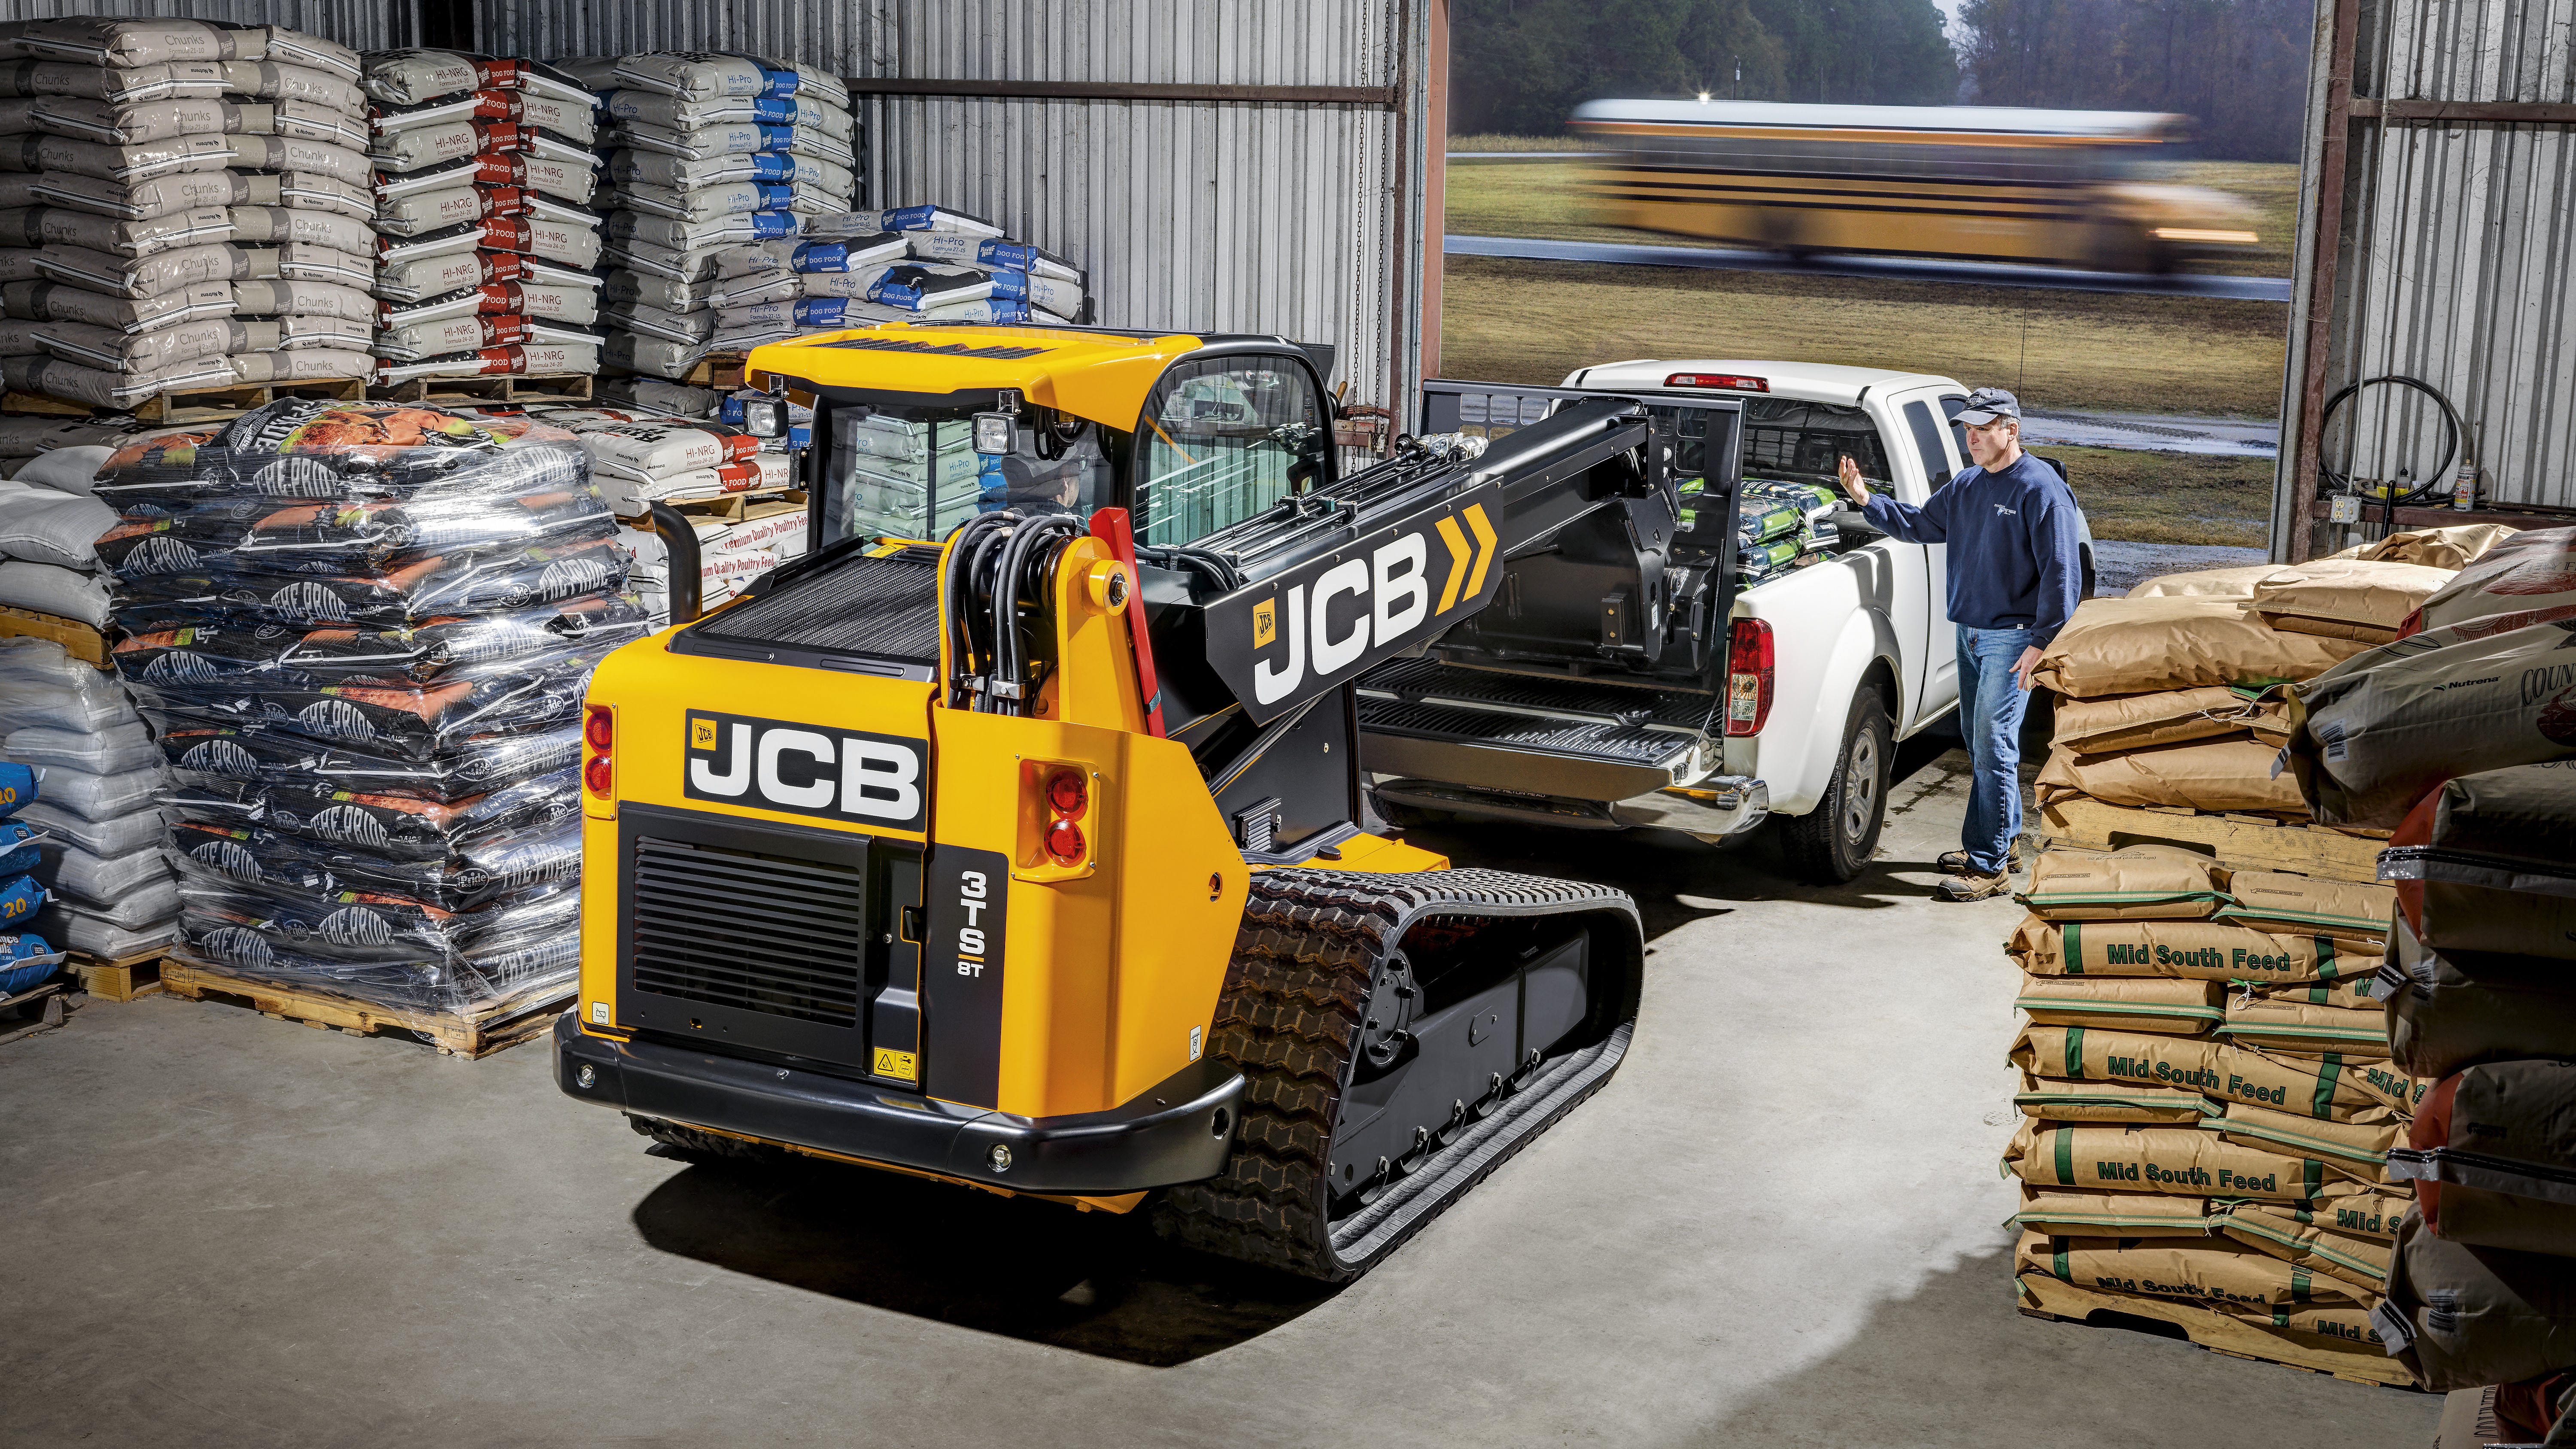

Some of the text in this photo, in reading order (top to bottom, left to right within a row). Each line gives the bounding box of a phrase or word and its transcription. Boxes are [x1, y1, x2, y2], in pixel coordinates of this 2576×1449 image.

[165, 35, 204, 46] Chunks
[221, 38, 234, 48] River
[223, 46, 233, 55] Run
[287, 52, 304, 61] Nutrena
[435, 67, 468, 79] HI-NRG
[478, 67, 489, 79] River
[481, 74, 489, 83] Run
[727, 194, 749, 204] Hi-Pro
[761, 194, 771, 203] River
[496, 230, 515, 238] FOOD
[518, 230, 530, 239] River
[535, 229, 567, 243] HI-NRG
[933, 236, 964, 246] Hi-Pro
[750, 305, 778, 313] Hi-Pro
[795, 306, 808, 315] River
[179, 329, 218, 345] Chunks
[232, 331, 246, 342] River
[233, 338, 244, 347] Run
[530, 351, 565, 361] HI-NRG
[686, 445, 714, 459] HI-NRG
[724, 444, 735, 456] River
[725, 452, 733, 460] Run
[616, 453, 634, 462] Nutrena
[949, 459, 969, 471] Hi-Pro
[253, 457, 342, 497] THE PRIDE
[765, 468, 790, 479] HI-NR
[752, 526, 774, 541] Quality
[774, 517, 797, 534] Poultry
[797, 516, 808, 528] Fee
[123, 537, 203, 576] THE PRIDE
[715, 561, 736, 574] Quality
[737, 559, 760, 571] Poultry
[762, 556, 774, 569] Feed
[271, 582, 348, 623] THE PRIDE
[1254, 532, 1428, 705] JCB
[1259, 613, 1272, 635] JCB
[143, 651, 222, 684] THE PRIDE
[2449, 676, 2500, 689] Nutrena
[298, 700, 377, 743] THE PRIDE
[698, 726, 712, 741] JCB
[181, 740, 259, 774] THE PRIDE
[690, 723, 920, 821] JCB
[277, 814, 298, 827] Pride
[546, 807, 566, 823] Pride
[310, 805, 392, 848] THE PRIDE
[460, 871, 488, 883] Pride
[3, 898, 27, 918] 20
[319, 907, 395, 944] THE PRIDE
[2107, 943, 2291, 974] Mid South Feed
[957, 961, 984, 978] 8T
[2108, 1056, 2286, 1106] Mid South Feed
[2367, 1067, 2409, 1099] Mid
[2097, 1161, 2277, 1193] Mid South Feed
[2336, 1209, 2381, 1233] Mid
[2095, 1277, 2266, 1304] Mid South Feed
[2318, 1319, 2362, 1339] Mid
